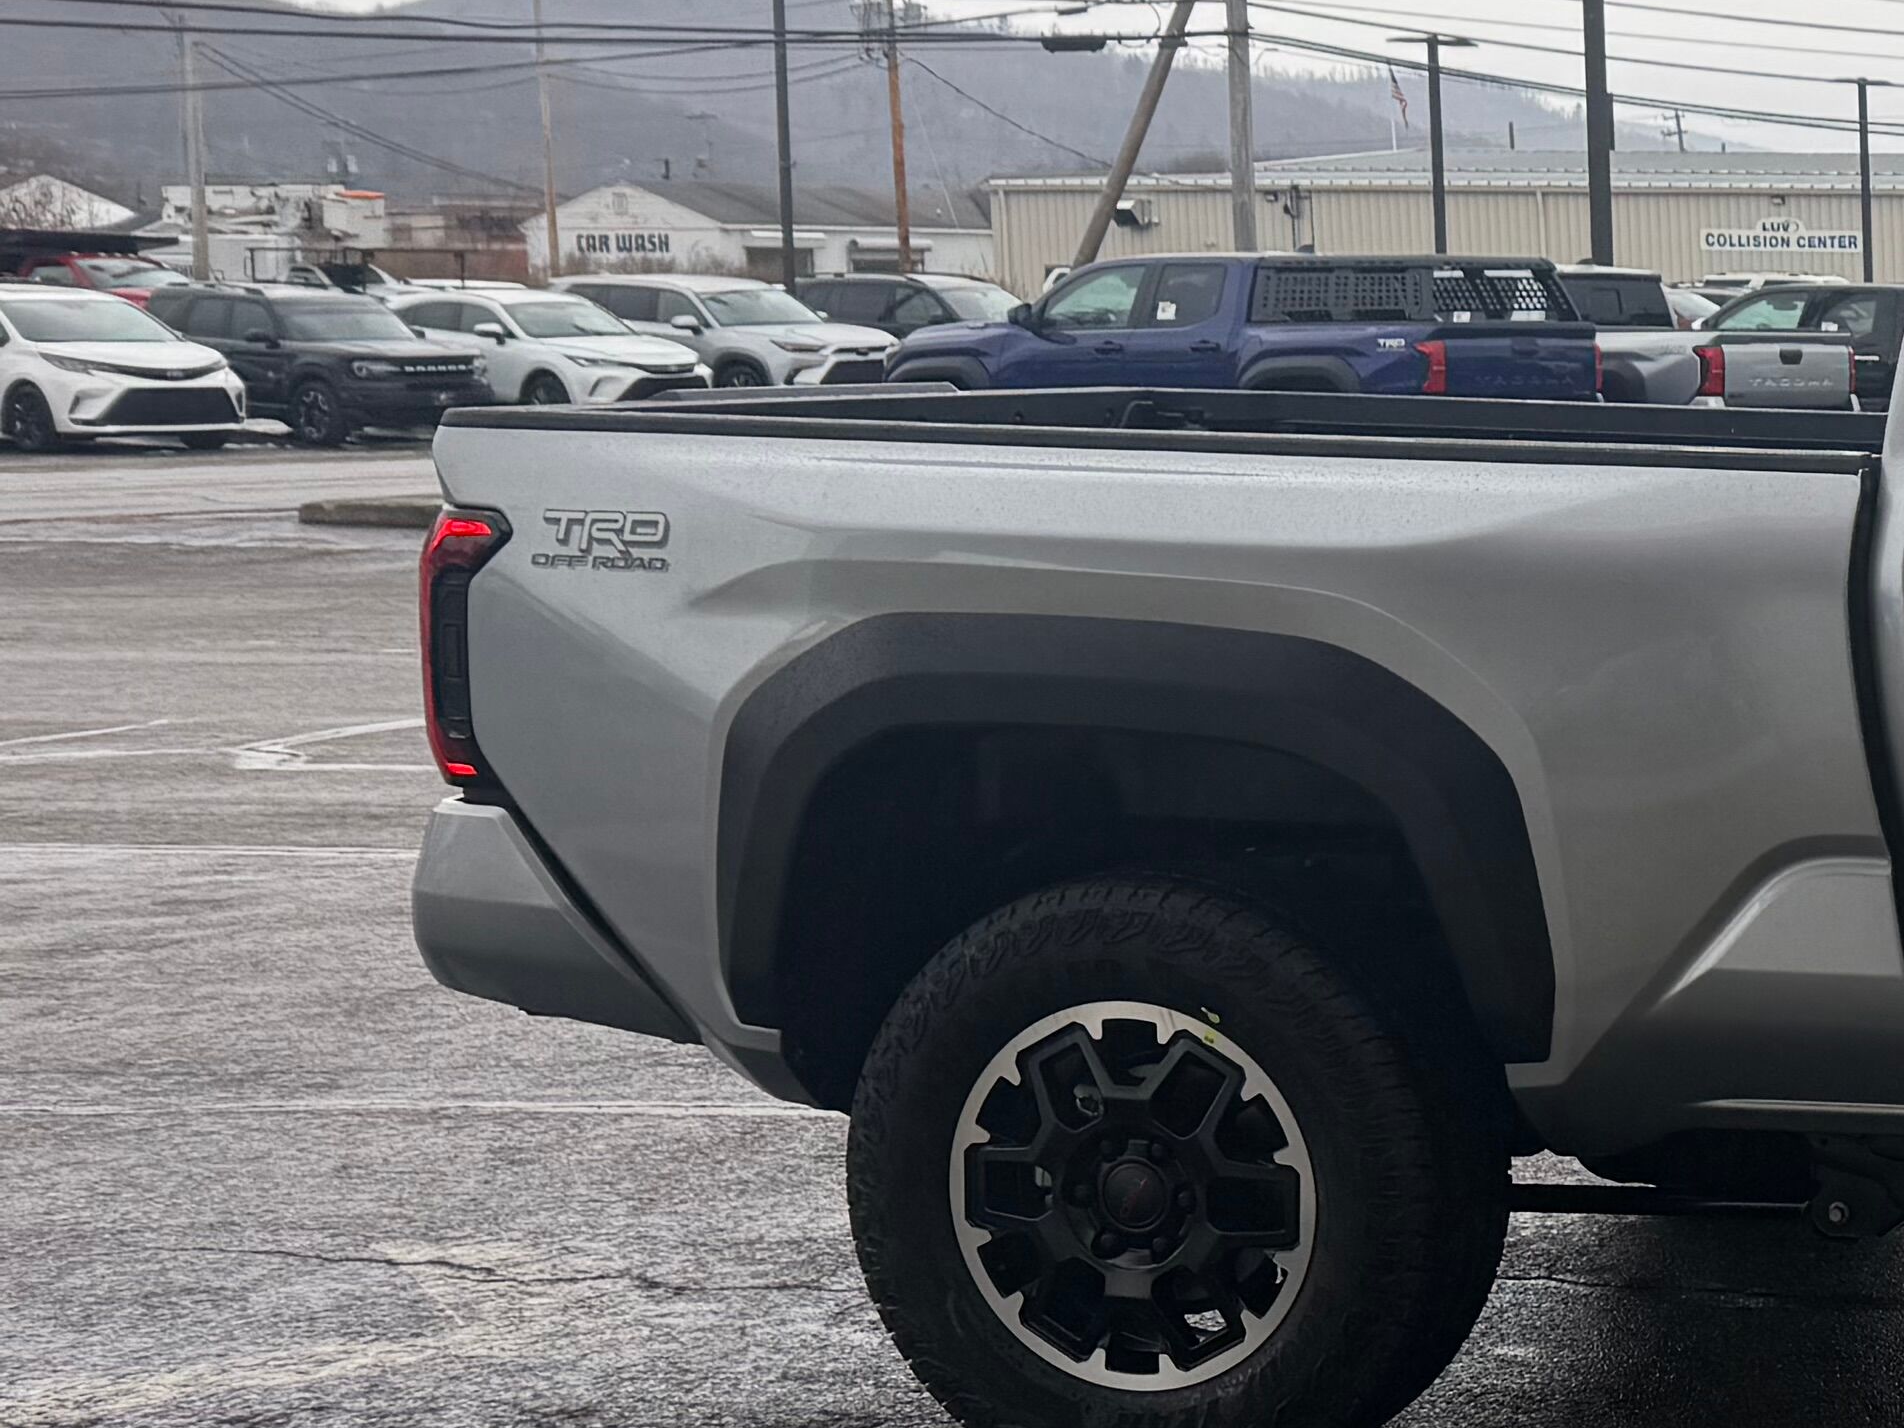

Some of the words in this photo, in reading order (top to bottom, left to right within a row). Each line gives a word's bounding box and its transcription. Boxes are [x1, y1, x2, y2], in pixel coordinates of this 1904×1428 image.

[1762, 222, 1790, 232] LUV
[576, 233, 610, 253] CAR
[615, 233, 669, 253] WASH
[1705, 232, 1791, 248] COLLISION
[1796, 234, 1858, 249] CENTER
[542, 508, 671, 557] TRD
[531, 553, 589, 570] OFF
[591, 555, 671, 572] ROAD
